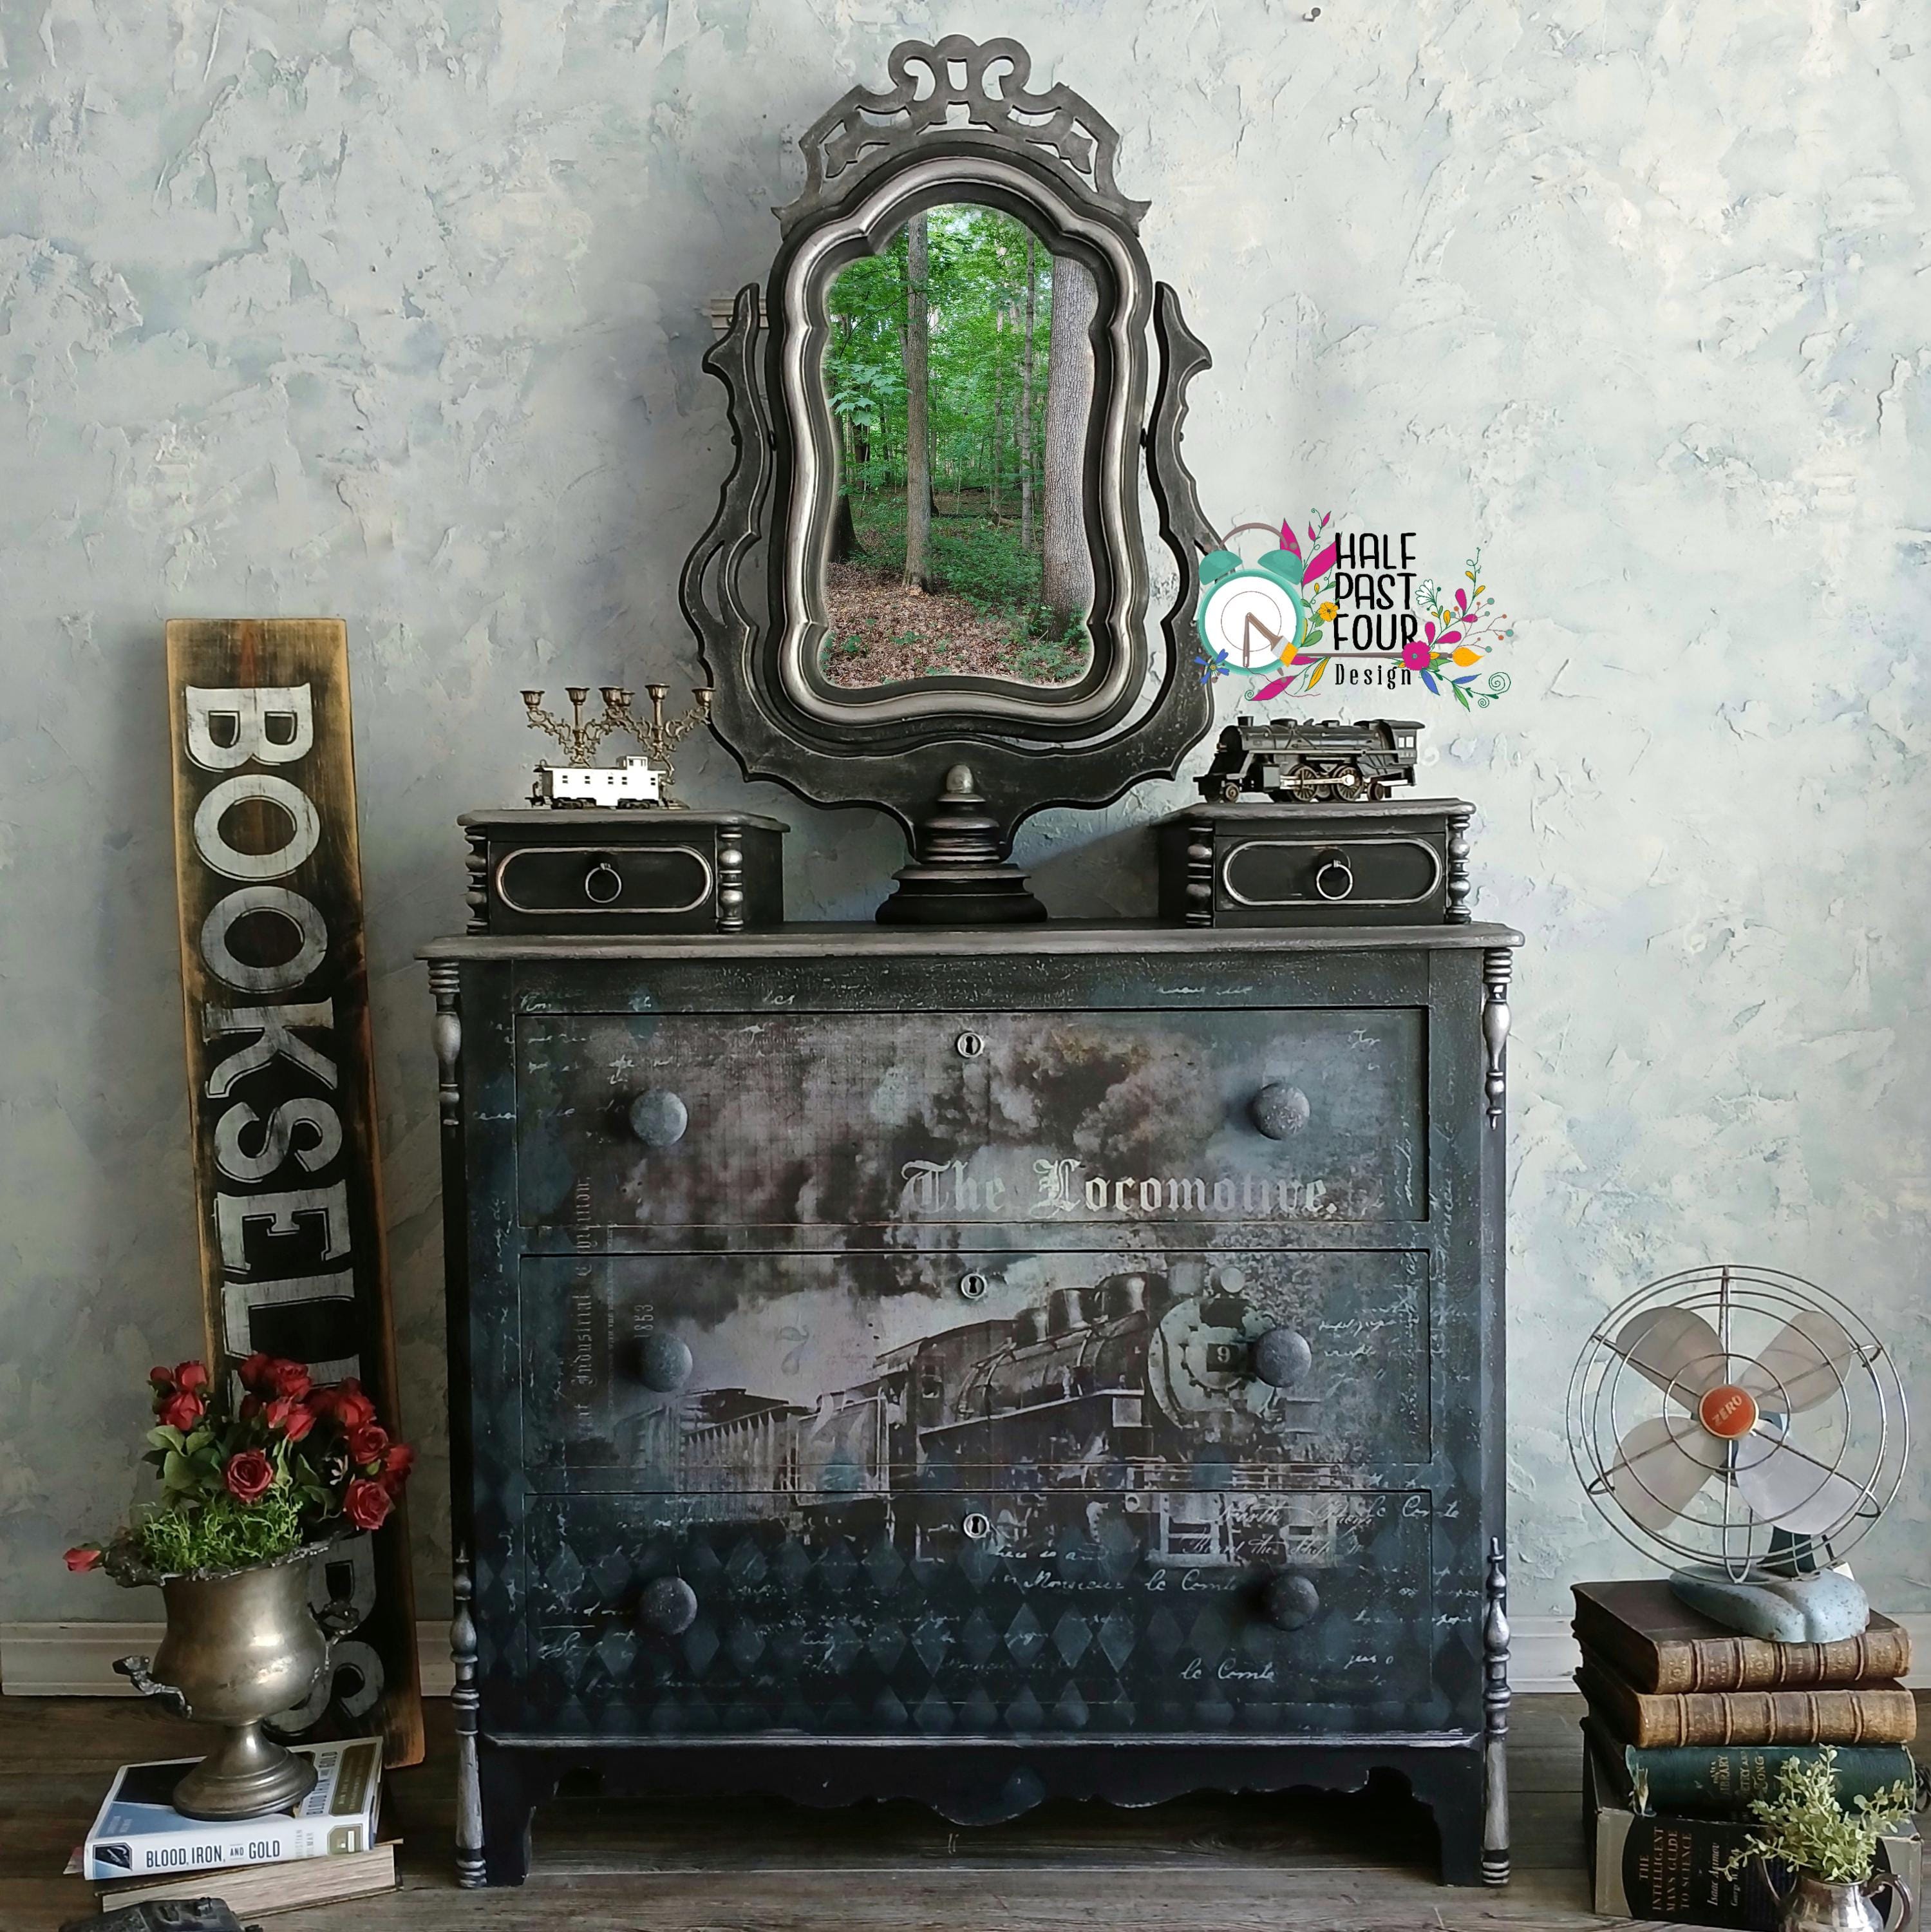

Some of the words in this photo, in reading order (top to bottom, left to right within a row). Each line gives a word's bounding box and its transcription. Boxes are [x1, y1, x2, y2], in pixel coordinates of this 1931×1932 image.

[901, 1159, 1006, 1213] The
[184, 683, 384, 1736] BOOKSELRS
[1217, 1346, 1230, 1363] 9
[1711, 1396, 1742, 1426] ZERO
[146, 1848, 189, 1868] BLOOD,
[192, 1844, 225, 1865] IRON,
[229, 1847, 244, 1857] AND
[249, 1840, 281, 1860] GOLD
[1668, 1830, 1679, 1871] GUIDE
[1681, 1833, 1692, 1888] SCIENCE
[1708, 1842, 1720, 1878] Asimov
[1639, 1855, 1649, 1880] THE
[1652, 1826, 1664, 1911] INTELLIGENT
[1680, 1892, 1690, 1909] TO
[1706, 1881, 1719, 1907] Isaac
